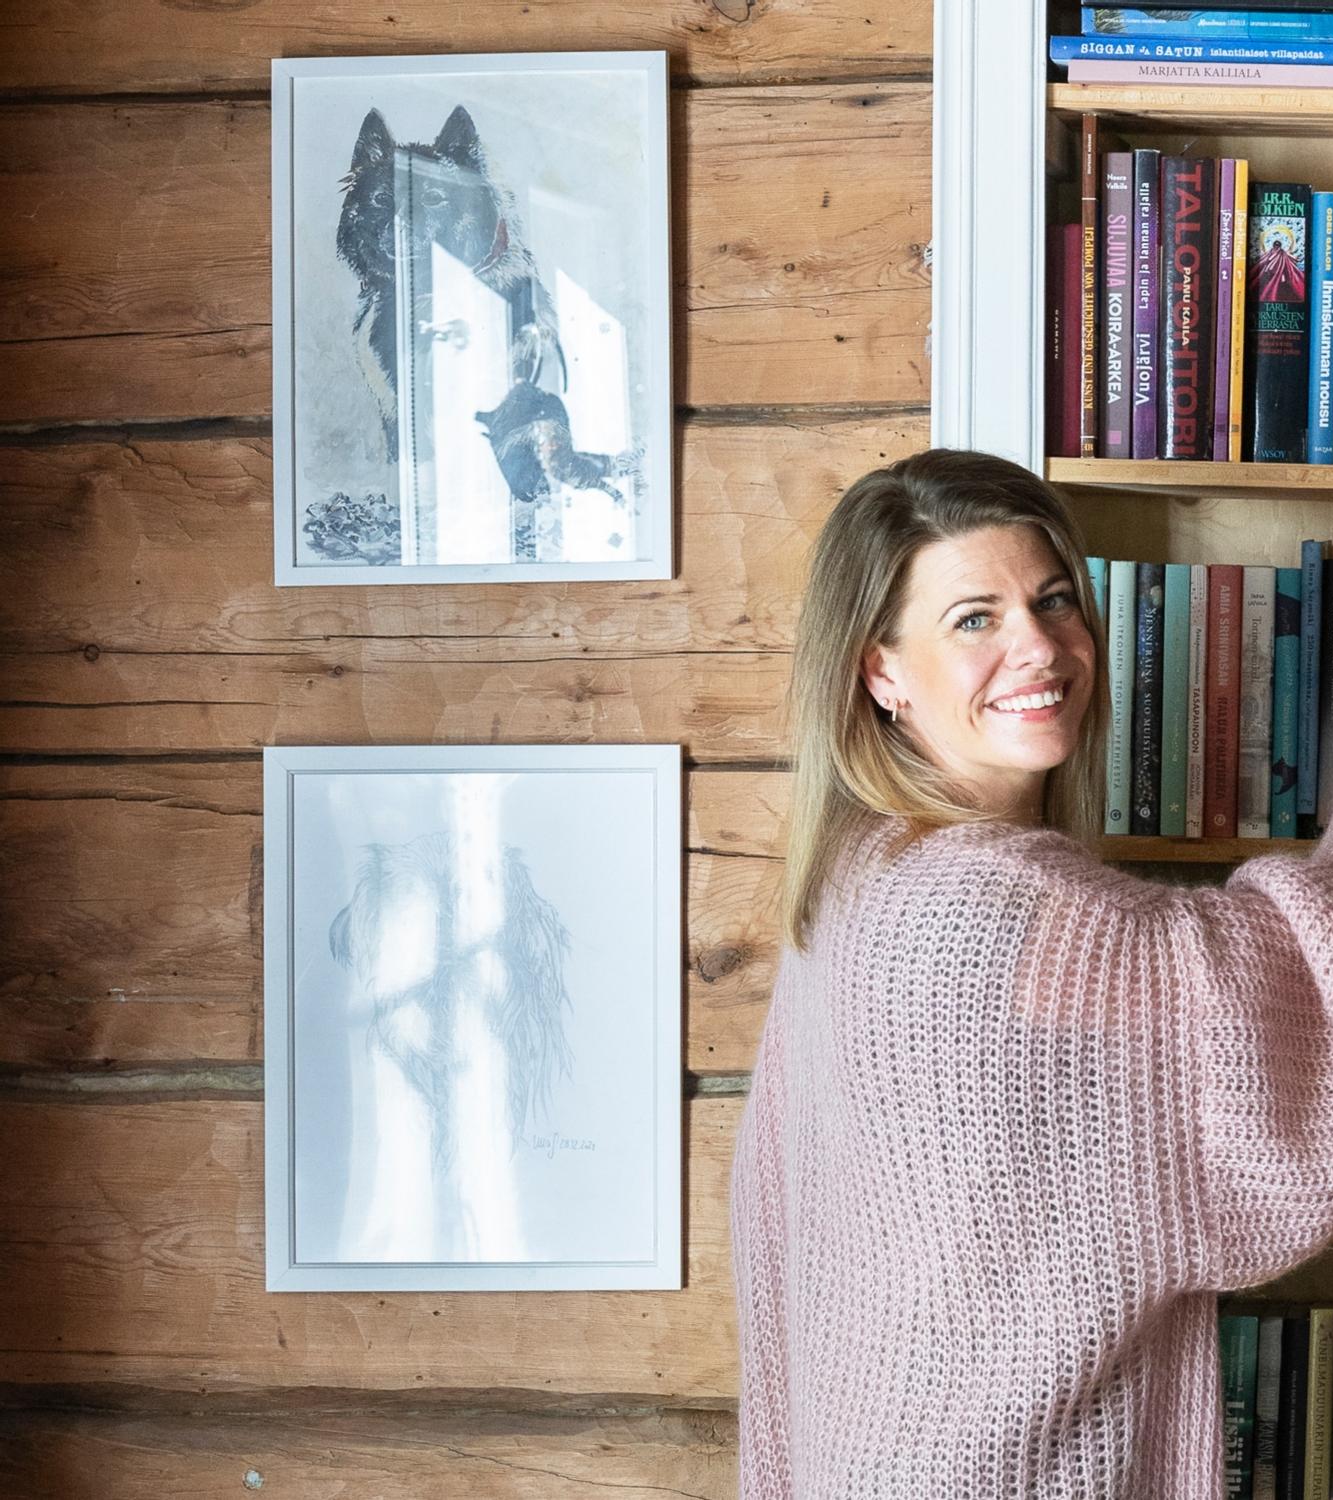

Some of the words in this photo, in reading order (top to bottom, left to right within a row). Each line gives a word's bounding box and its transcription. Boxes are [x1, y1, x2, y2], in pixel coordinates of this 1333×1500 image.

[1080, 43, 1134, 56] SIGGAN
[1139, 47, 1151, 56] JA
[1155, 46, 1203, 57] SATUN
[1210, 47, 1268, 58] islantilaiset
[1271, 49, 1324, 61] villapaidat
[1139, 66, 1201, 78] MARJATTA
[1204, 67, 1261, 78] KALLIALA
[1140, 182, 1150, 217] rajalla
[1107, 214, 1125, 287] SUJUVAA
[1139, 222, 1149, 259] lannan
[1139, 263, 1150, 273] ja
[1182, 267, 1191, 303] PANU
[1139, 279, 1149, 309] Lapin
[1265, 304, 1288, 312] TARU
[1181, 307, 1191, 346] KAILA
[1108, 293, 1122, 403] KOIRA-ARKEA
[1135, 333, 1152, 405] Vuojärvi
[1319, 381, 1333, 427] nousu
[1225, 1401, 1245, 1461] Lisää
